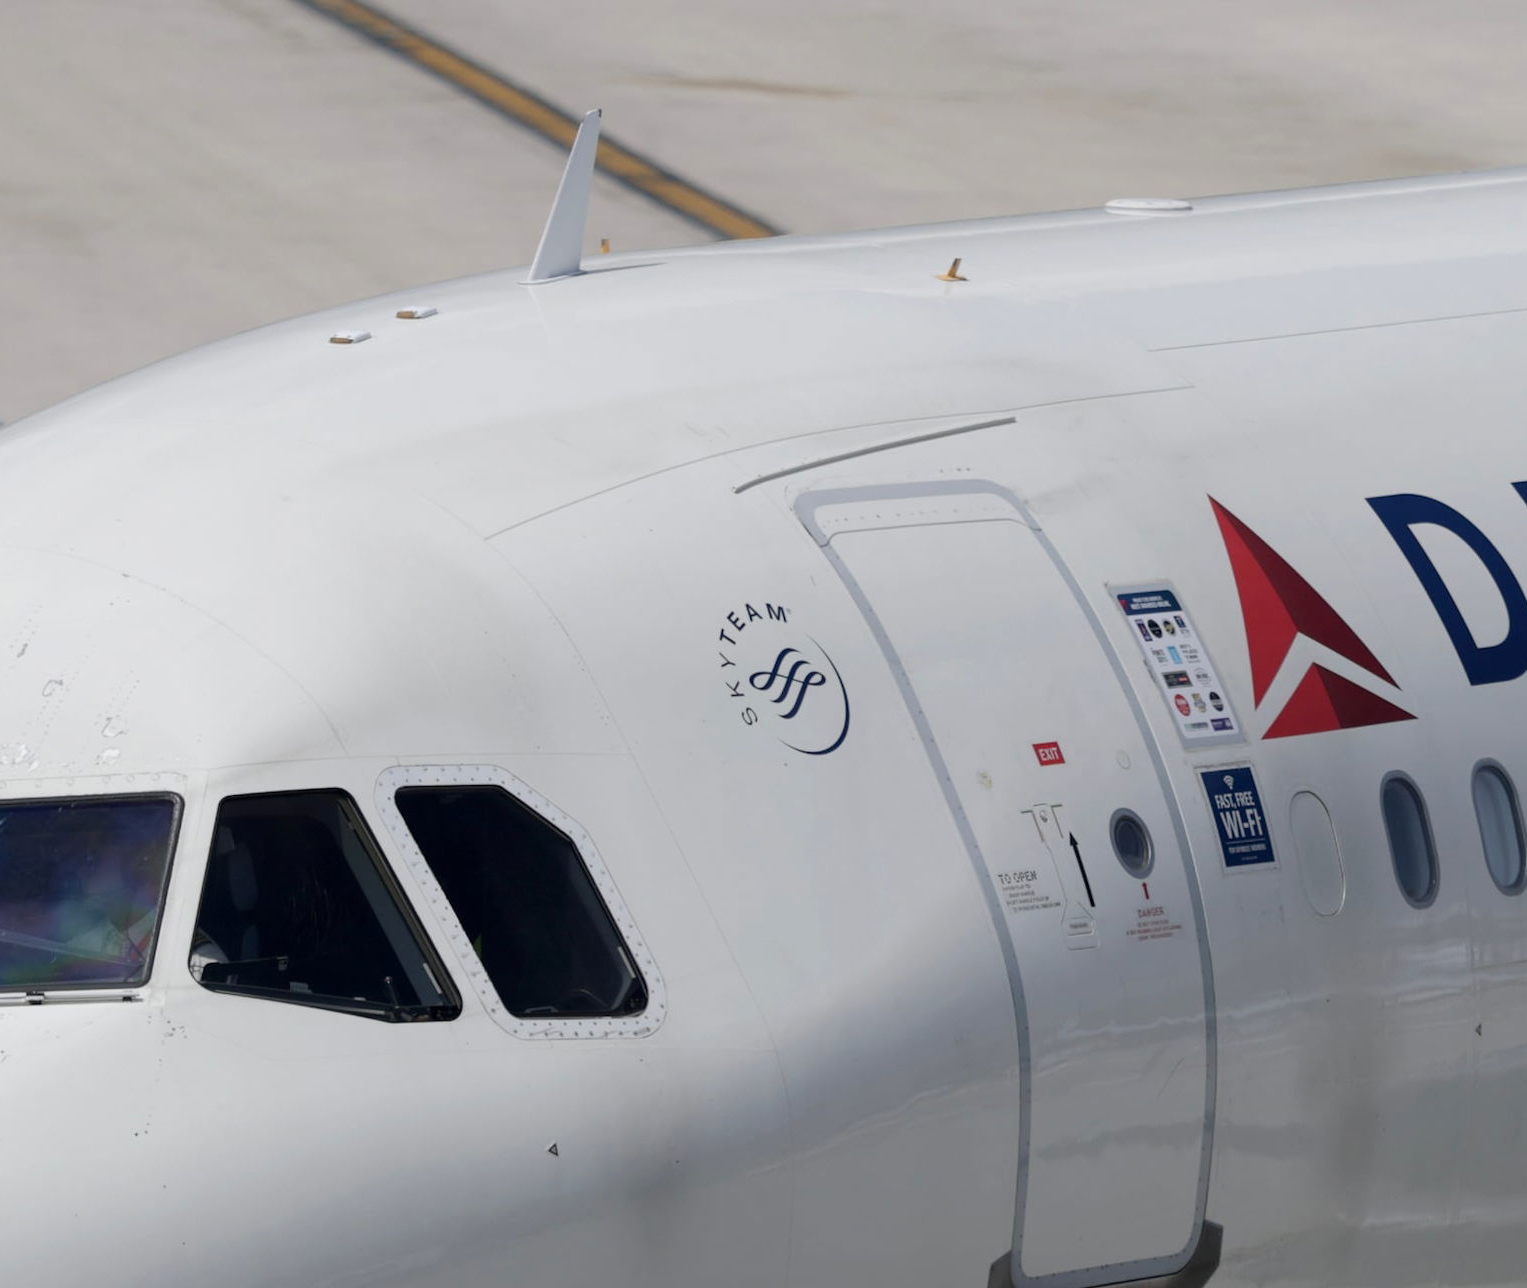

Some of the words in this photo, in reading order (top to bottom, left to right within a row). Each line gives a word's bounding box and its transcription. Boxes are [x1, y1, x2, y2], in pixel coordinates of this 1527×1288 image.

[719, 603, 788, 726] SKYTEAM
[1038, 746, 1060, 762] EXIT
[1235, 790, 1255, 807] FREE
[1220, 808, 1263, 840] WI-FI
[998, 873, 1011, 885] TO
[1012, 869, 1038, 884] OPEN
